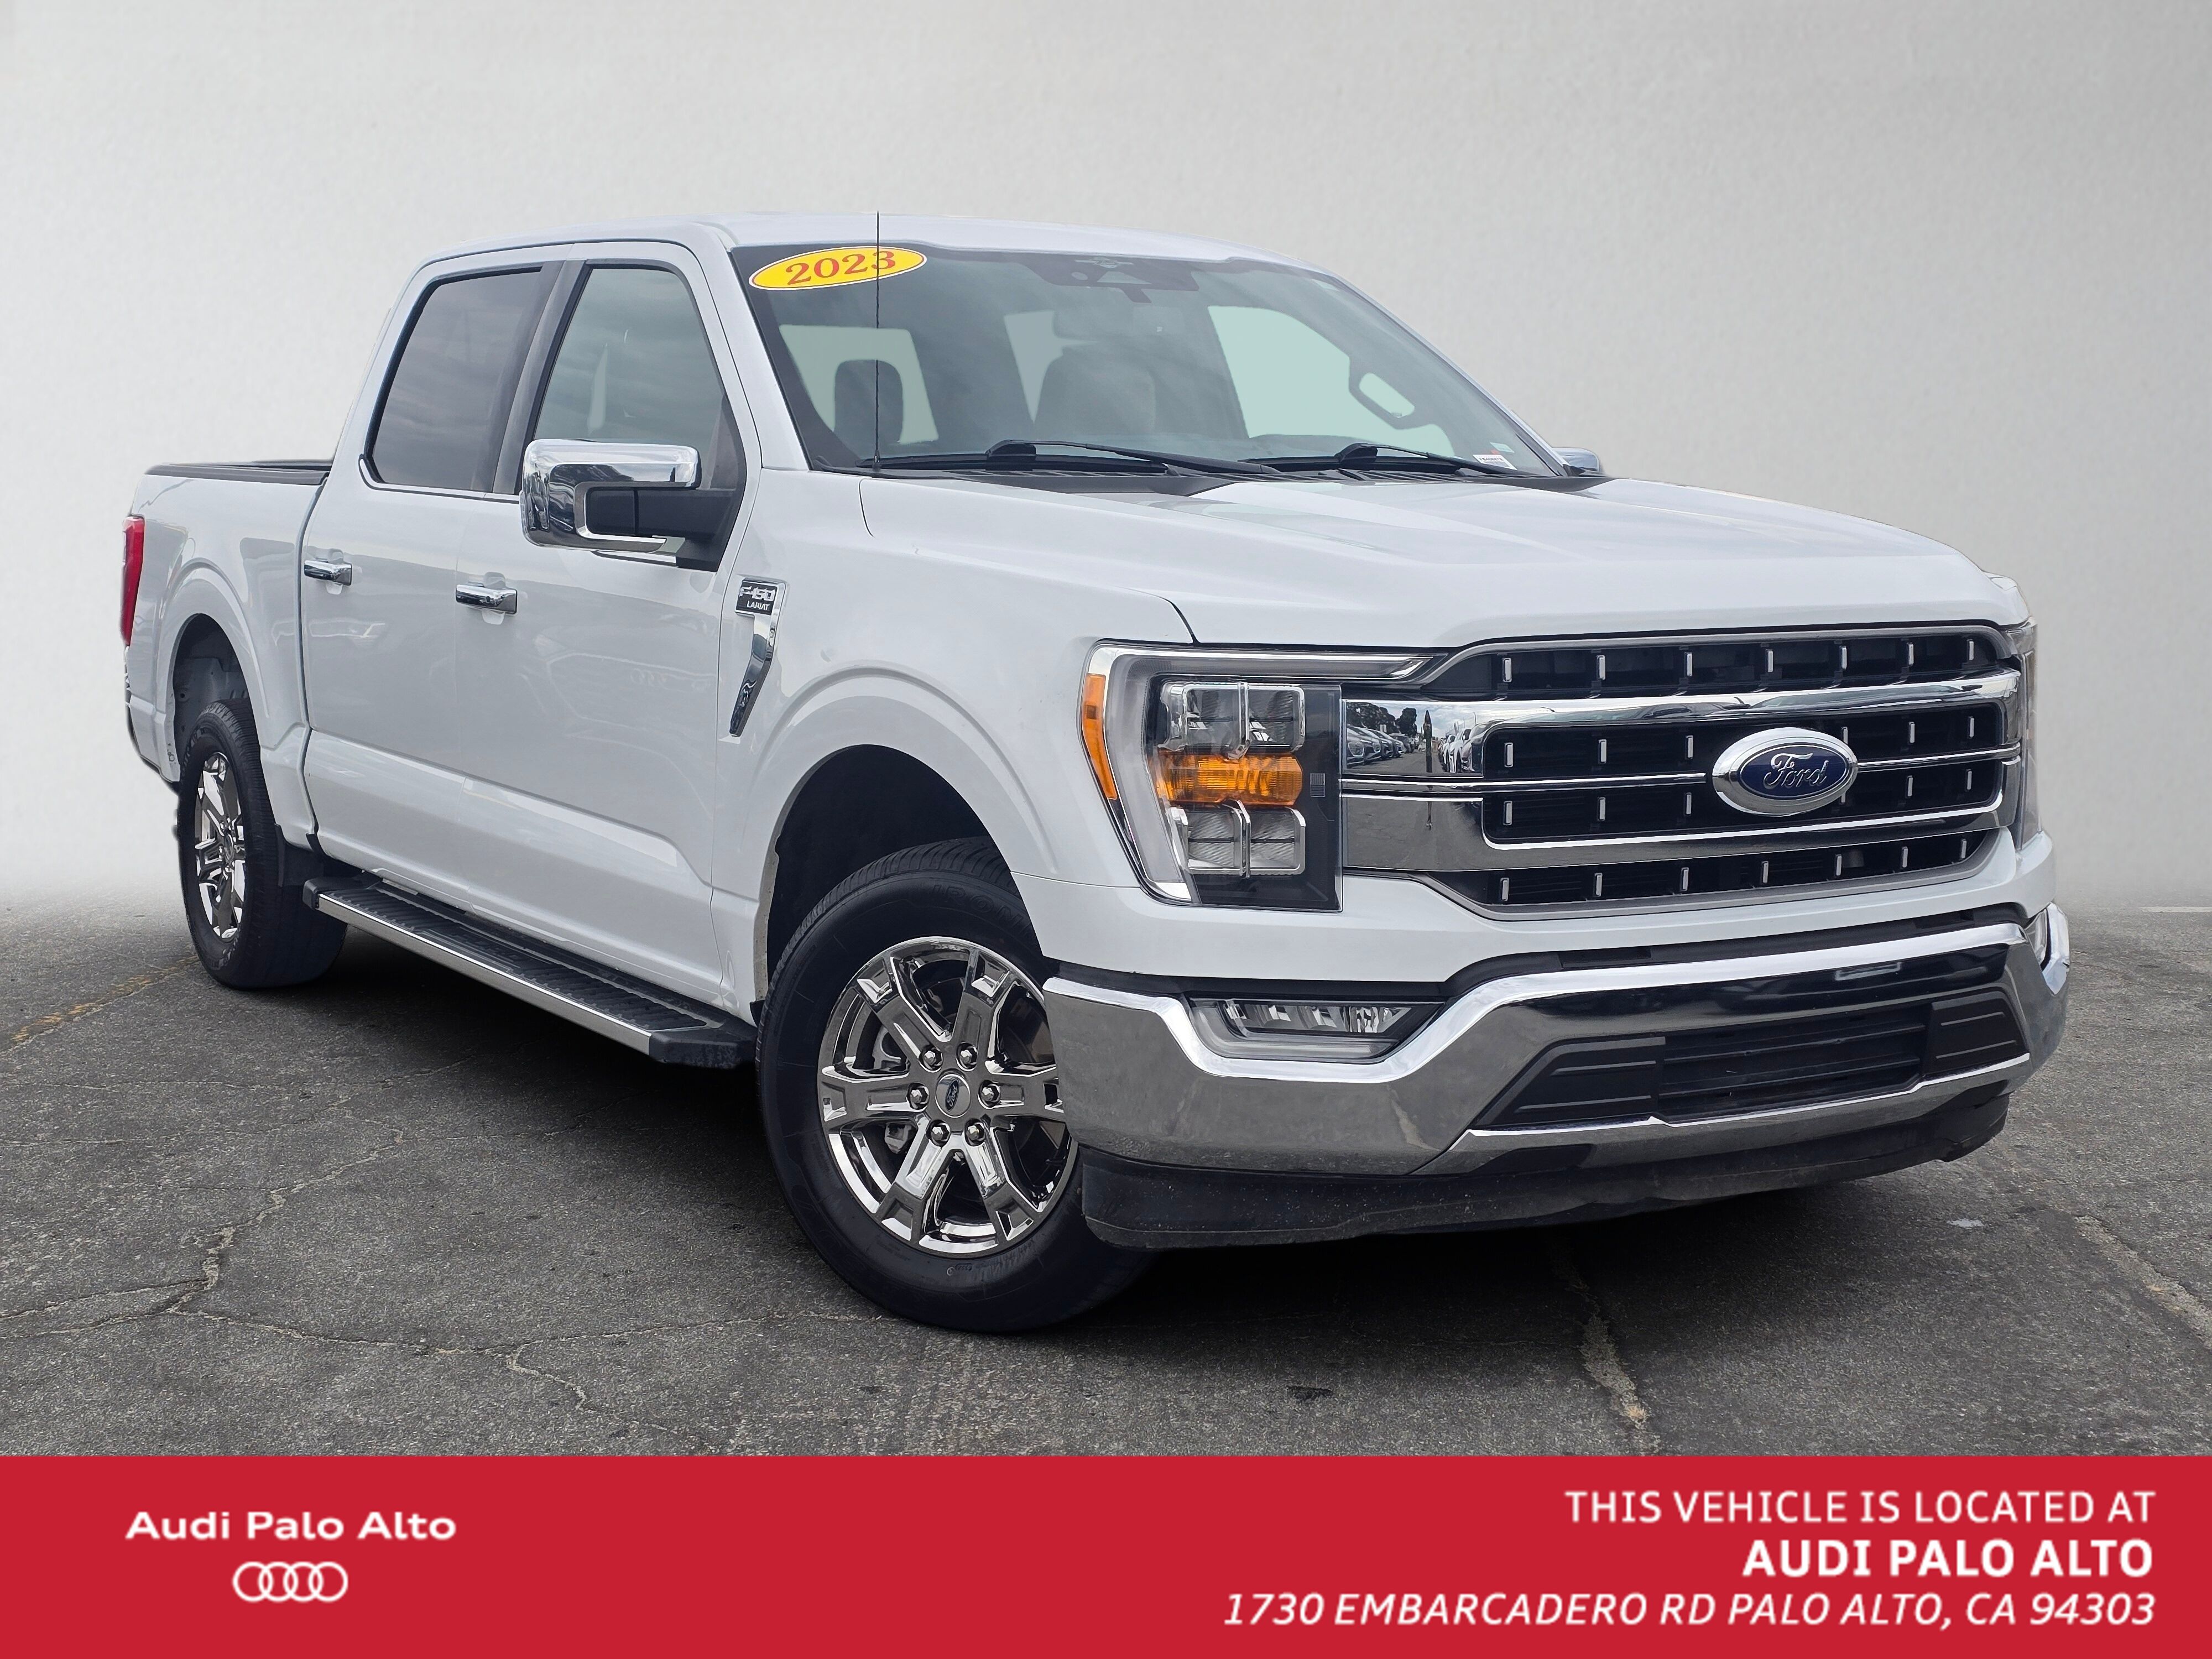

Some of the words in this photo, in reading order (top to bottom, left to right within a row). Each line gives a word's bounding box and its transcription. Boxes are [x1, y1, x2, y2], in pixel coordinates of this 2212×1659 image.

[785, 251, 896, 285] 2023
[747, 600, 770, 611] LARIAT
[1763, 753, 1829, 789] Ford
[946, 1082, 958, 1107] Ford
